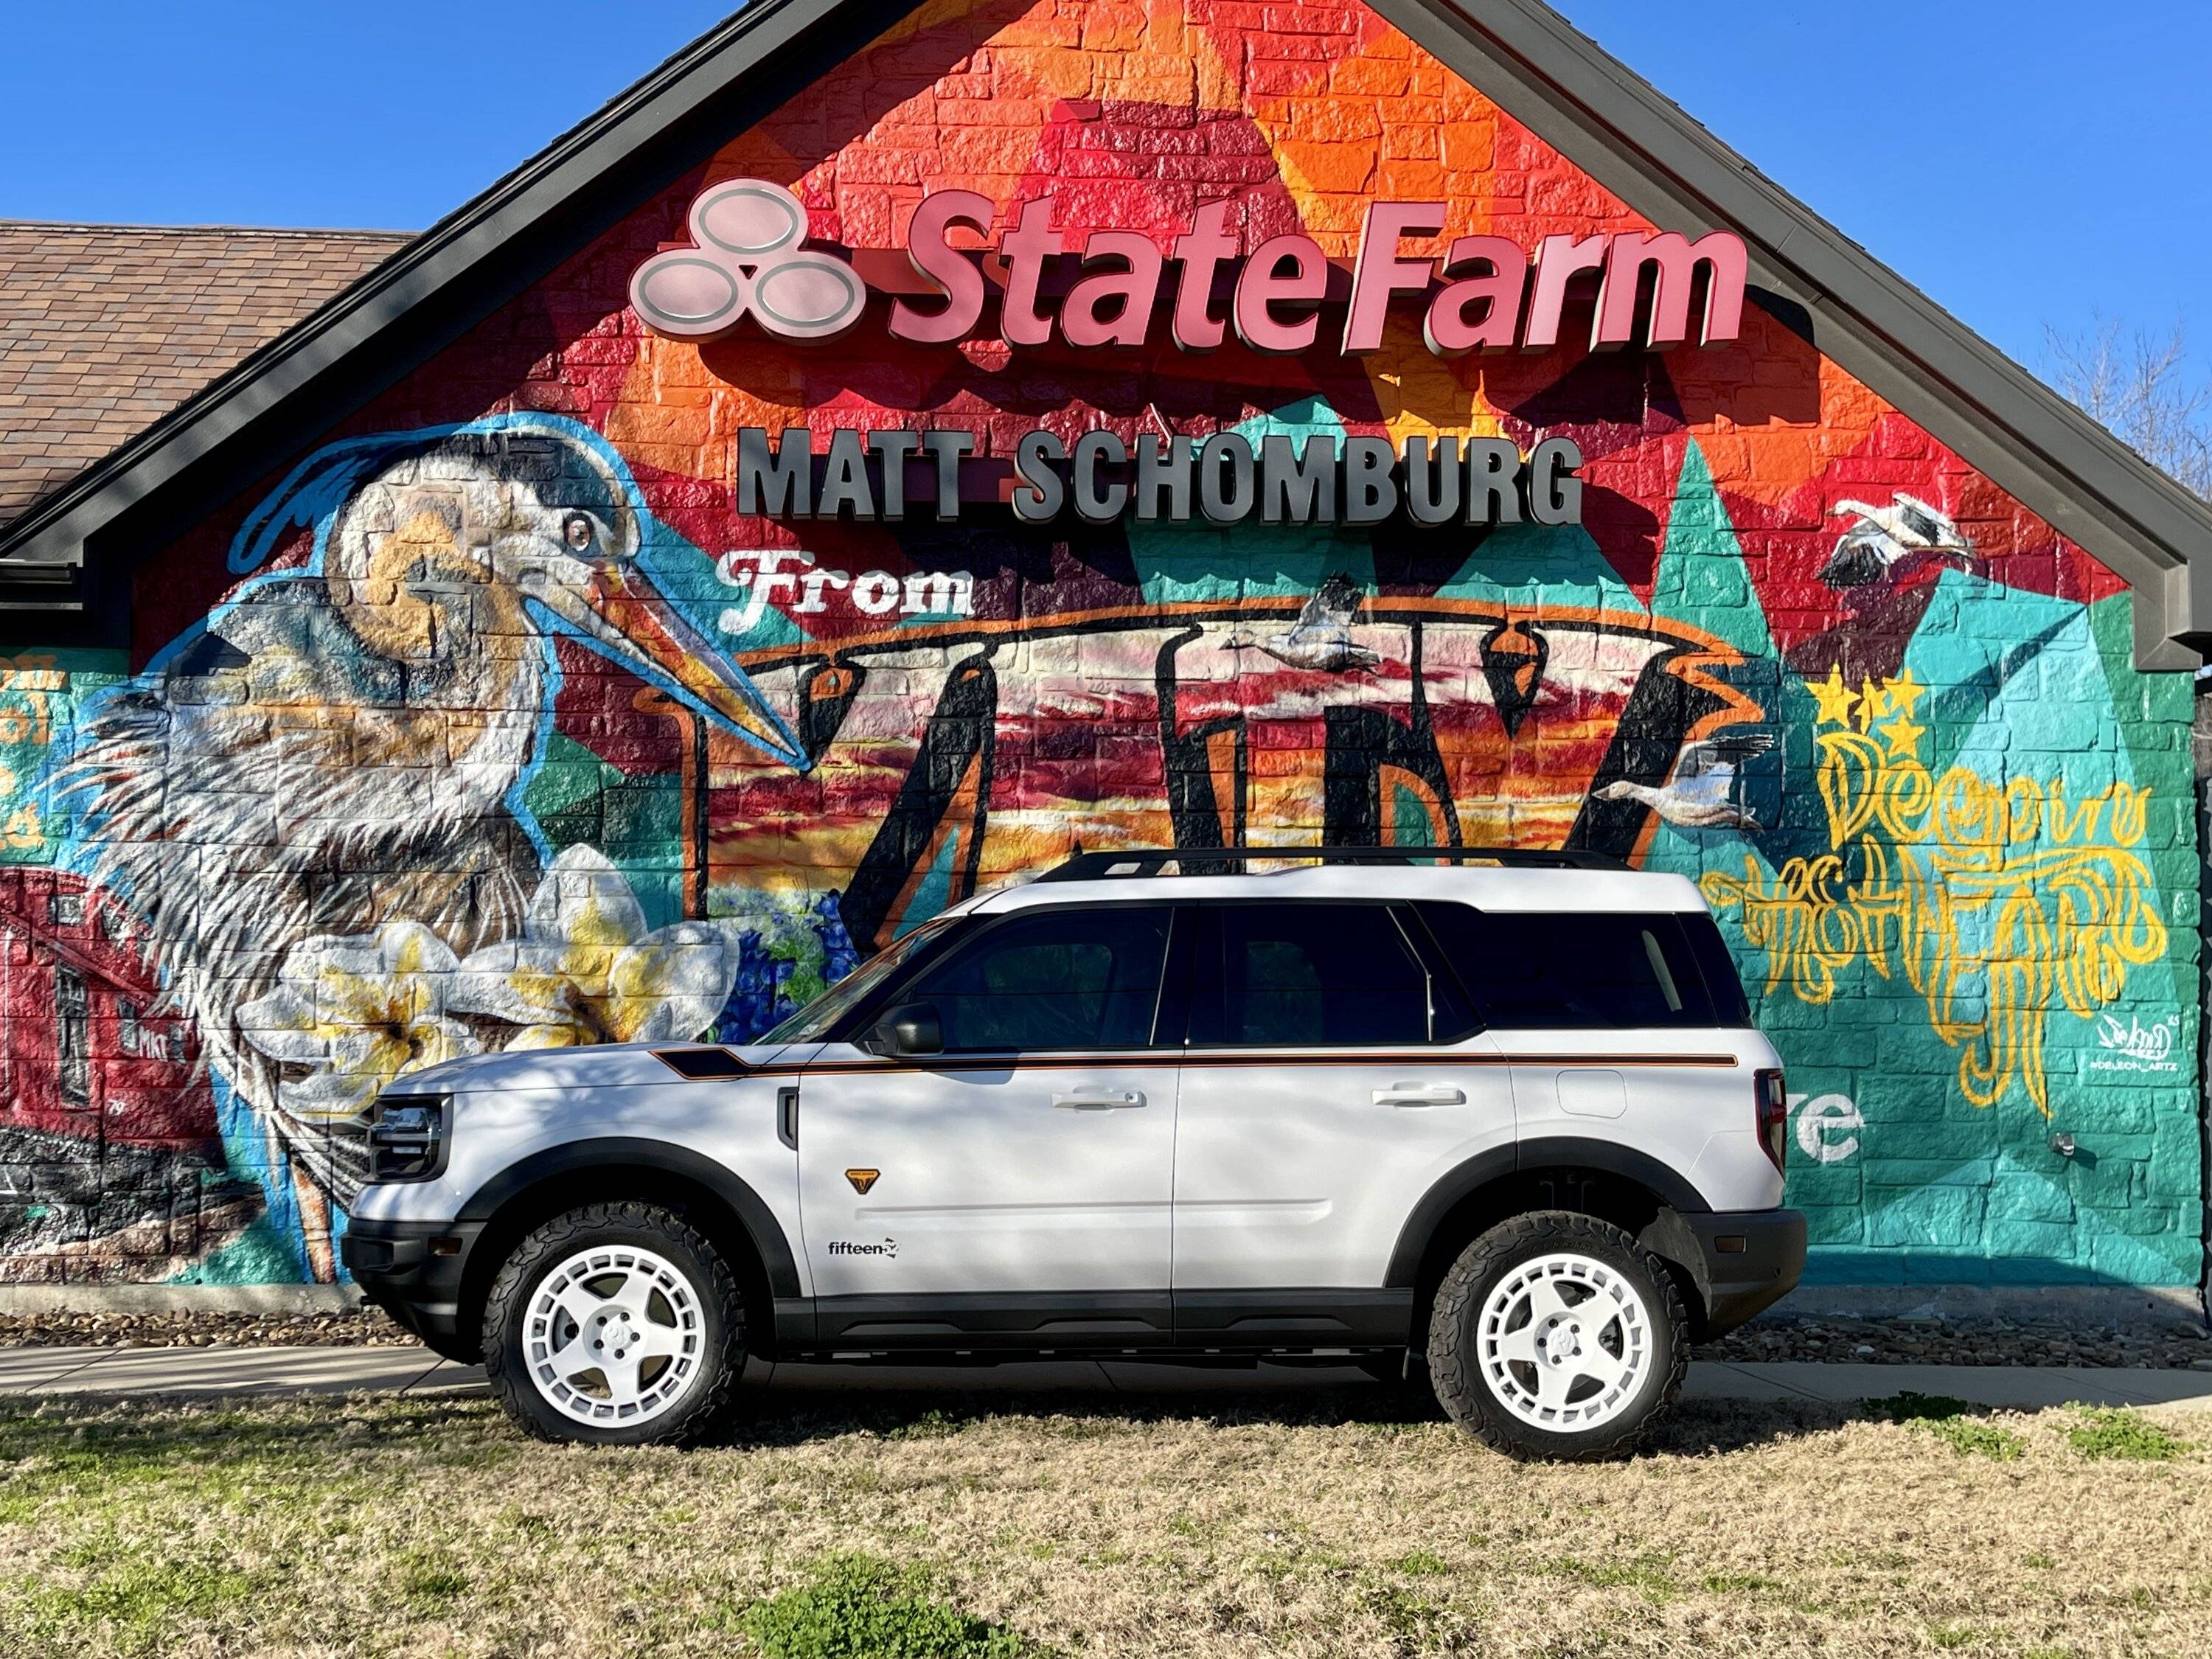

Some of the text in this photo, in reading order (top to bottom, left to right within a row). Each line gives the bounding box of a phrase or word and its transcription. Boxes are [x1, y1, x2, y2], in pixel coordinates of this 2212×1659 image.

[887, 189, 1748, 356] State Farm
[737, 426, 1583, 525] MATT SCHOMBURG
[715, 549, 975, 636] From
